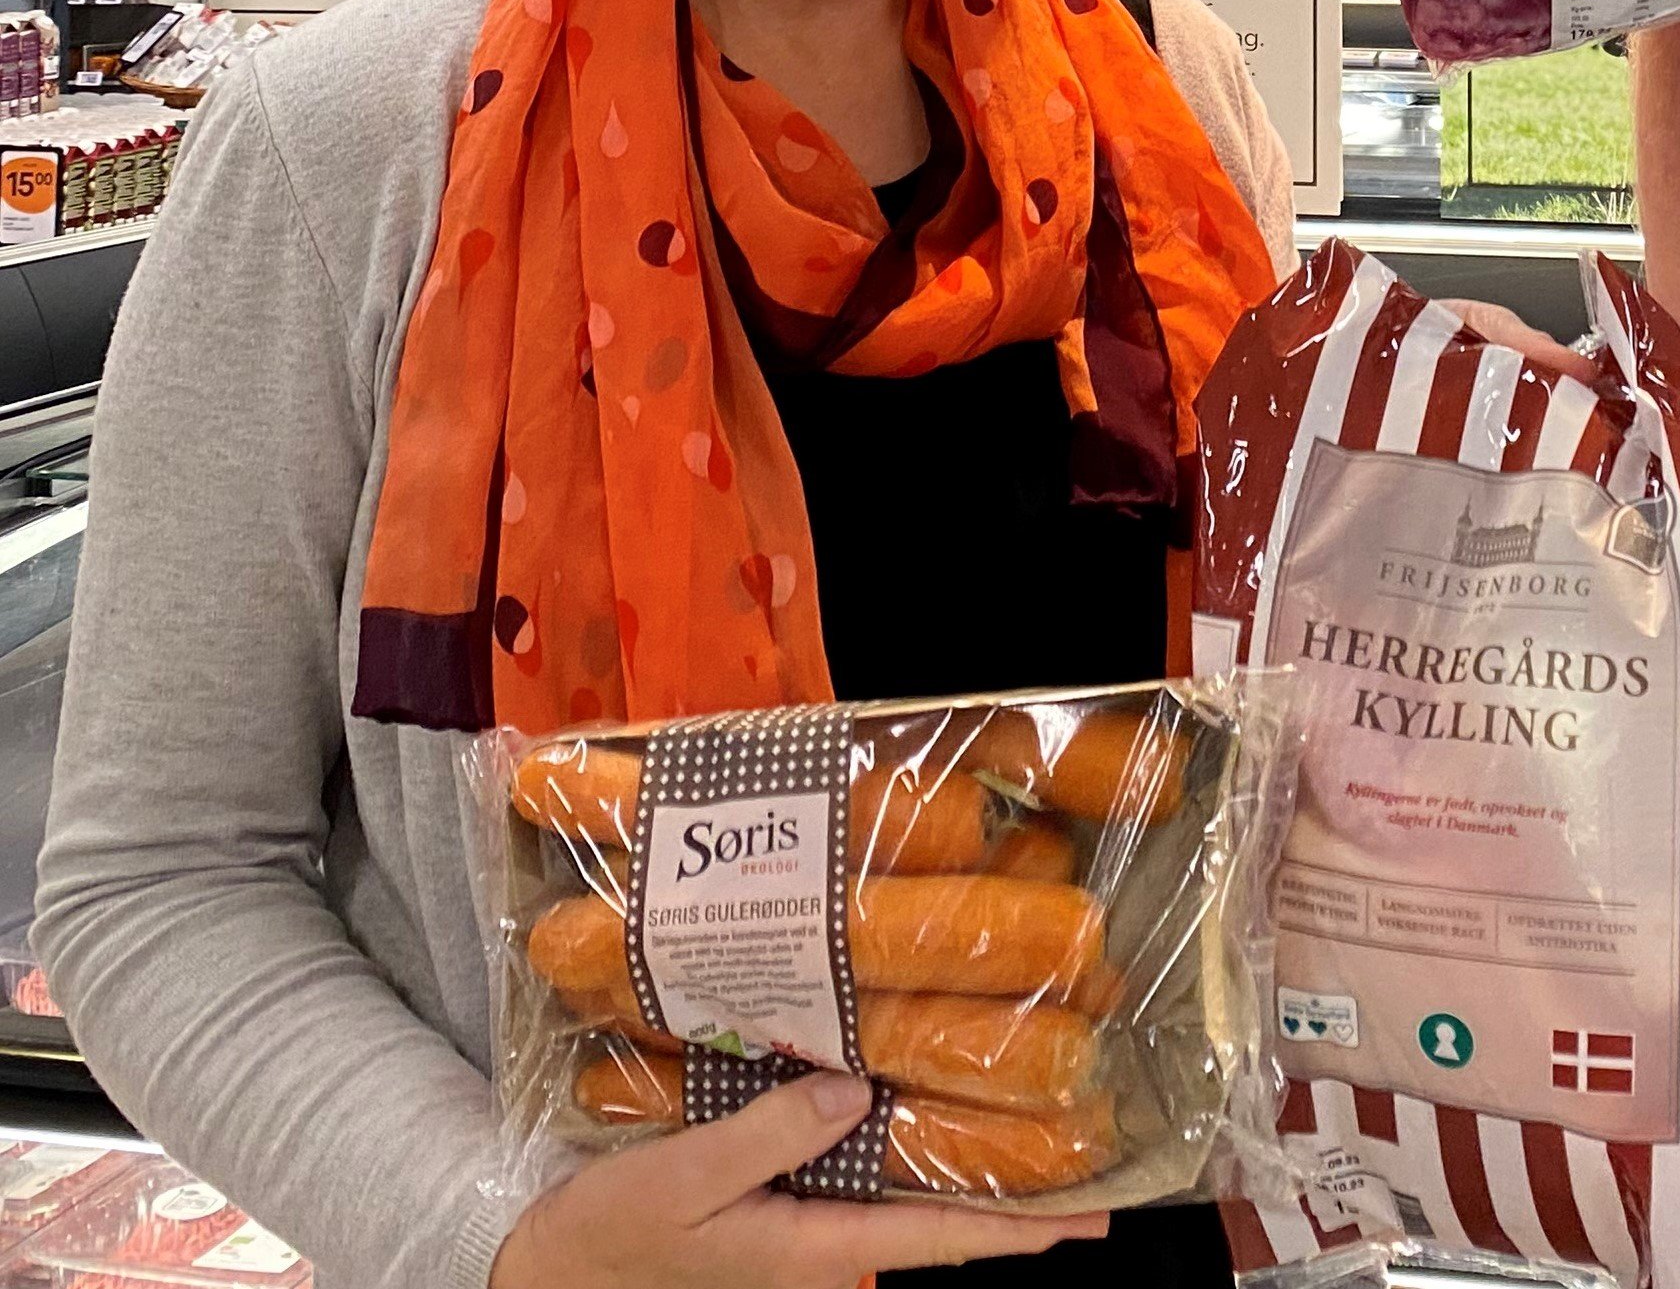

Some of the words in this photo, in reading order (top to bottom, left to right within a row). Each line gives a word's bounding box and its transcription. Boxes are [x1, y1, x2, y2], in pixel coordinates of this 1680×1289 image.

[1380, 561, 1593, 598] FRIJSENBORG
[1299, 620, 1650, 698] HERREGÅRDS
[1351, 688, 1579, 752] KYLLING
[675, 810, 799, 883] Søris
[648, 904, 699, 927] SØRIS
[704, 897, 821, 923] GULERØDDER
